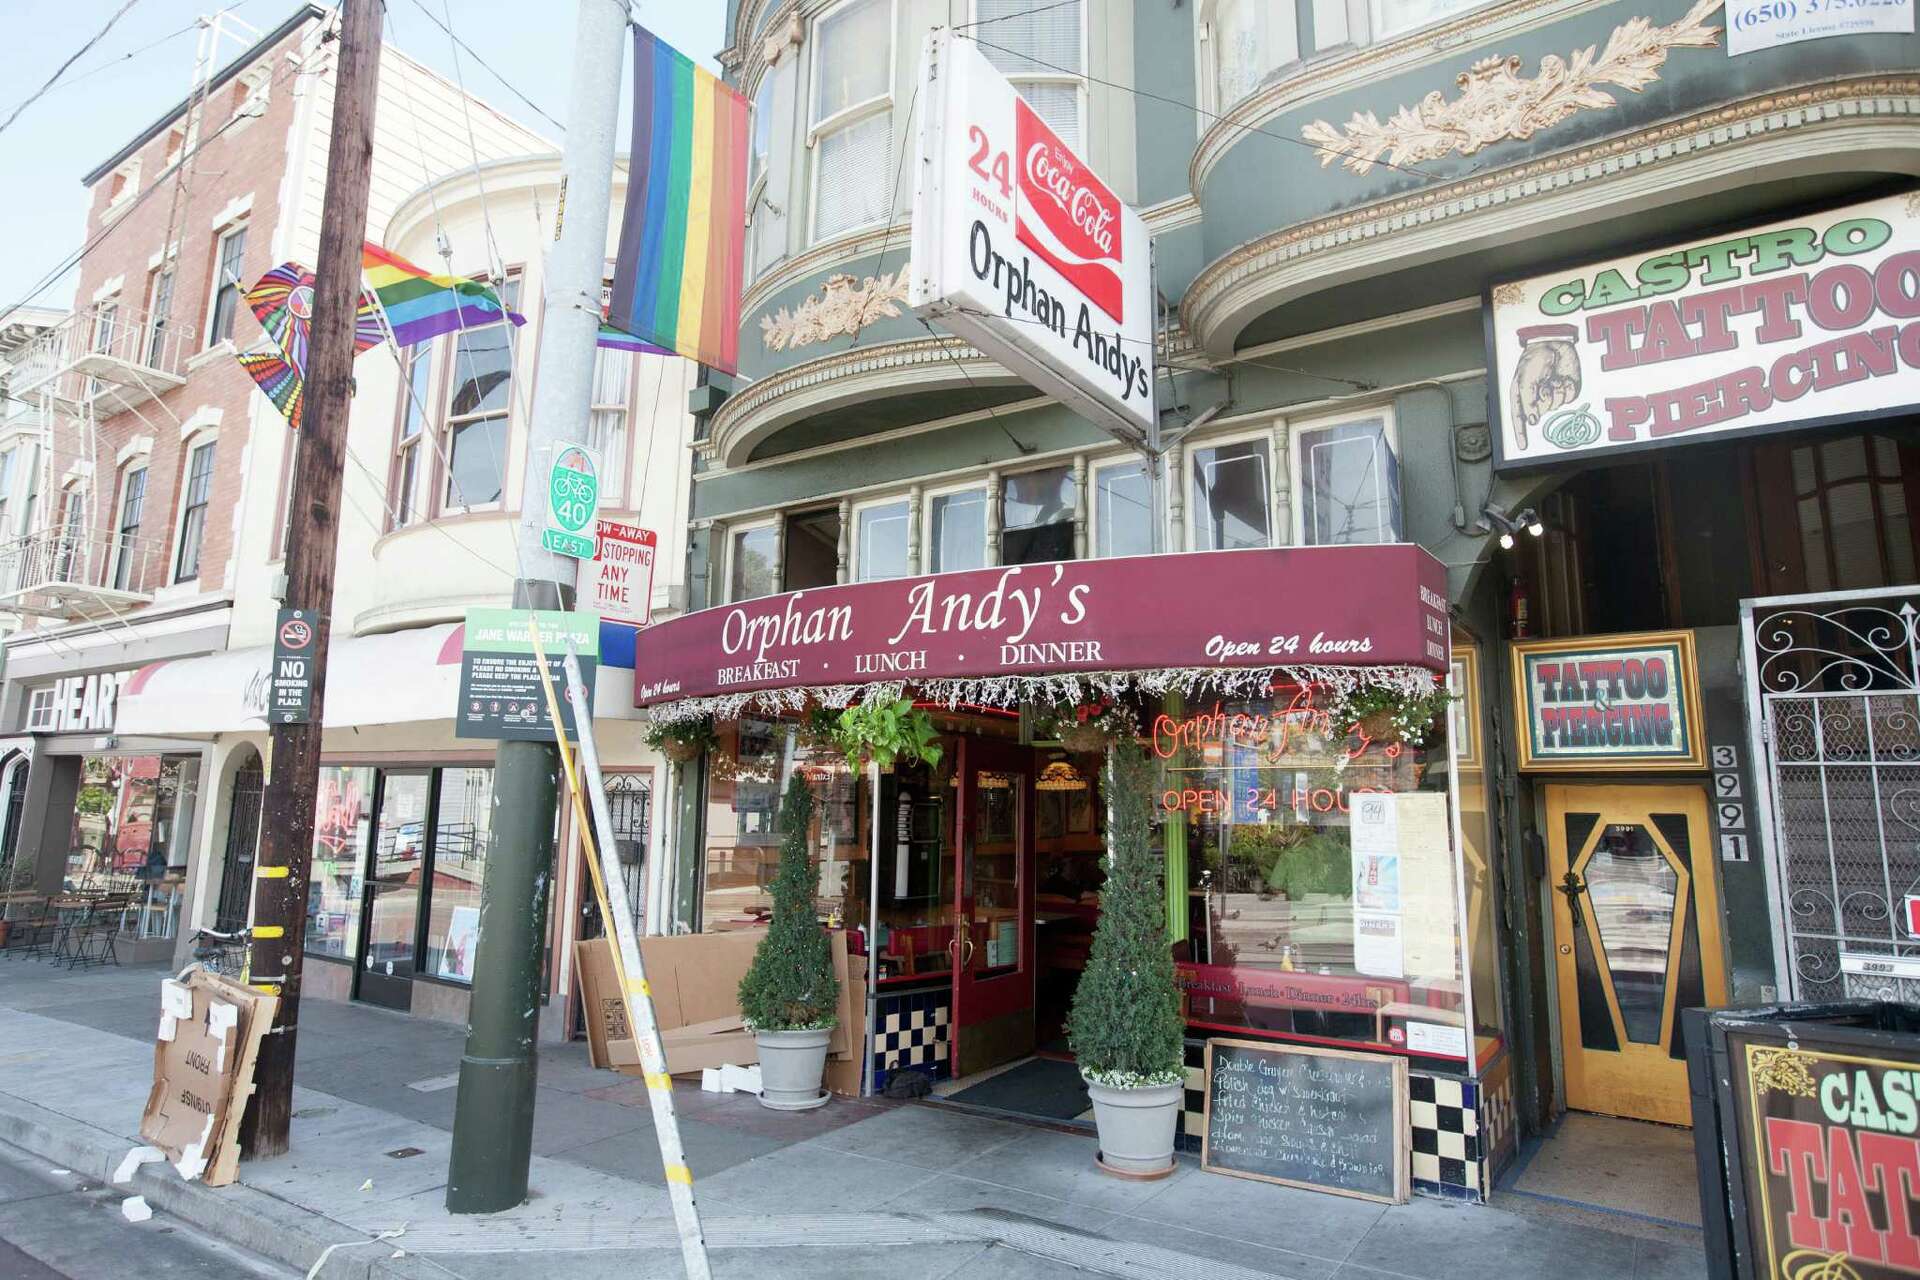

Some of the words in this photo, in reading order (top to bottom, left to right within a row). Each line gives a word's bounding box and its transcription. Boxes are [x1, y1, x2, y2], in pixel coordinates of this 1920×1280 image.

[1735, 3, 1797, 32] (650)
[968, 125, 1014, 200] 24
[1054, 145, 1074, 176] Enjoy
[972, 187, 1008, 224] HOURS
[1026, 142, 1115, 254] Coca-Cola
[1539, 217, 1893, 317] CASTRO
[969, 219, 1066, 339] Orphan
[1073, 302, 1148, 400] Andy's
[1586, 250, 1920, 372] TATTOO
[557, 499, 587, 526] 40
[552, 535, 585, 555] EAST
[596, 521, 650, 541] OW-AWAY
[603, 542, 651, 567] STOPPING
[601, 564, 629, 583] ANY
[598, 583, 630, 603] TIME
[722, 592, 854, 663] Orphan
[888, 564, 1090, 645] Andy's
[476, 628, 505, 641] JANE
[507, 629, 552, 643] WARER
[1205, 634, 1260, 662] Open
[1268, 634, 1300, 655] 24
[1309, 631, 1373, 654] hours
[280, 661, 305, 678] NO
[717, 659, 800, 686] BREAKFAST
[854, 650, 928, 674] LUNCH
[999, 640, 1104, 666] DINNER
[274, 680, 308, 688] SMOKING
[279, 689, 287, 697] IN
[288, 689, 302, 697] THE
[641, 684, 653, 702] Open
[653, 681, 662, 696] 24
[662, 679, 680, 694] hours
[1536, 657, 1669, 703] TATTOO
[278, 698, 302, 706] PLAZA
[1593, 687, 1616, 713] &
[1153, 700, 1270, 759] Orphan
[1541, 702, 1673, 748] PIERCING
[1163, 788, 1231, 812] OPEN
[1246, 788, 1276, 812] 24
[186, 1050, 211, 1075] FRONT
[1820, 1069, 1920, 1135] CAS
[1765, 1116, 1920, 1274] TAT
